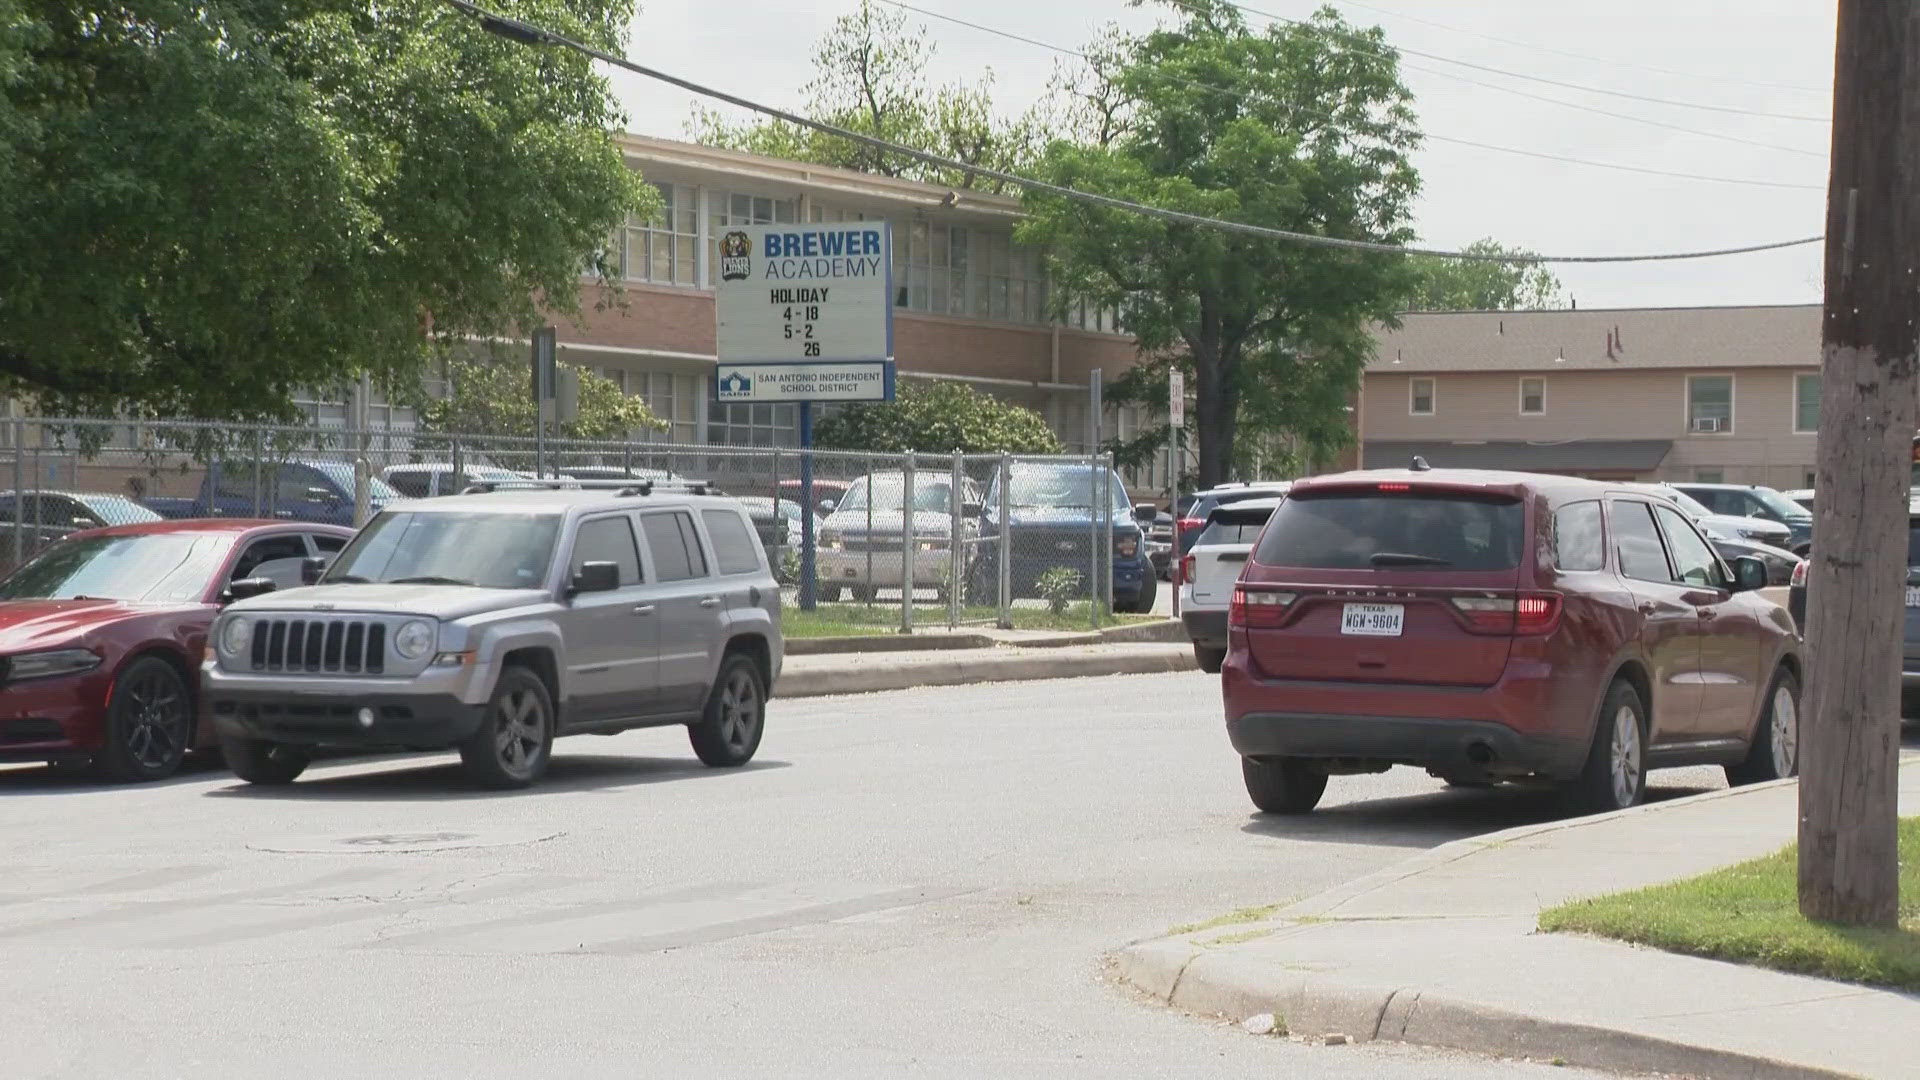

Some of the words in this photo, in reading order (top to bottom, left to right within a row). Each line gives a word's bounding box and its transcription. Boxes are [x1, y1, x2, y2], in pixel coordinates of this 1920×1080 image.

[765, 230, 880, 257] BREWER
[723, 263, 750, 276] LIONS
[765, 257, 881, 279] ACADEMY
[770, 288, 829, 304] HOLIDAY
[804, 342, 820, 357] 26
[758, 375, 776, 383] SAN
[778, 374, 818, 382] ANTONIO
[819, 372, 881, 381] INDEPENDENT
[780, 384, 816, 393] SCHOOL
[819, 383, 858, 392] DISTRICT
